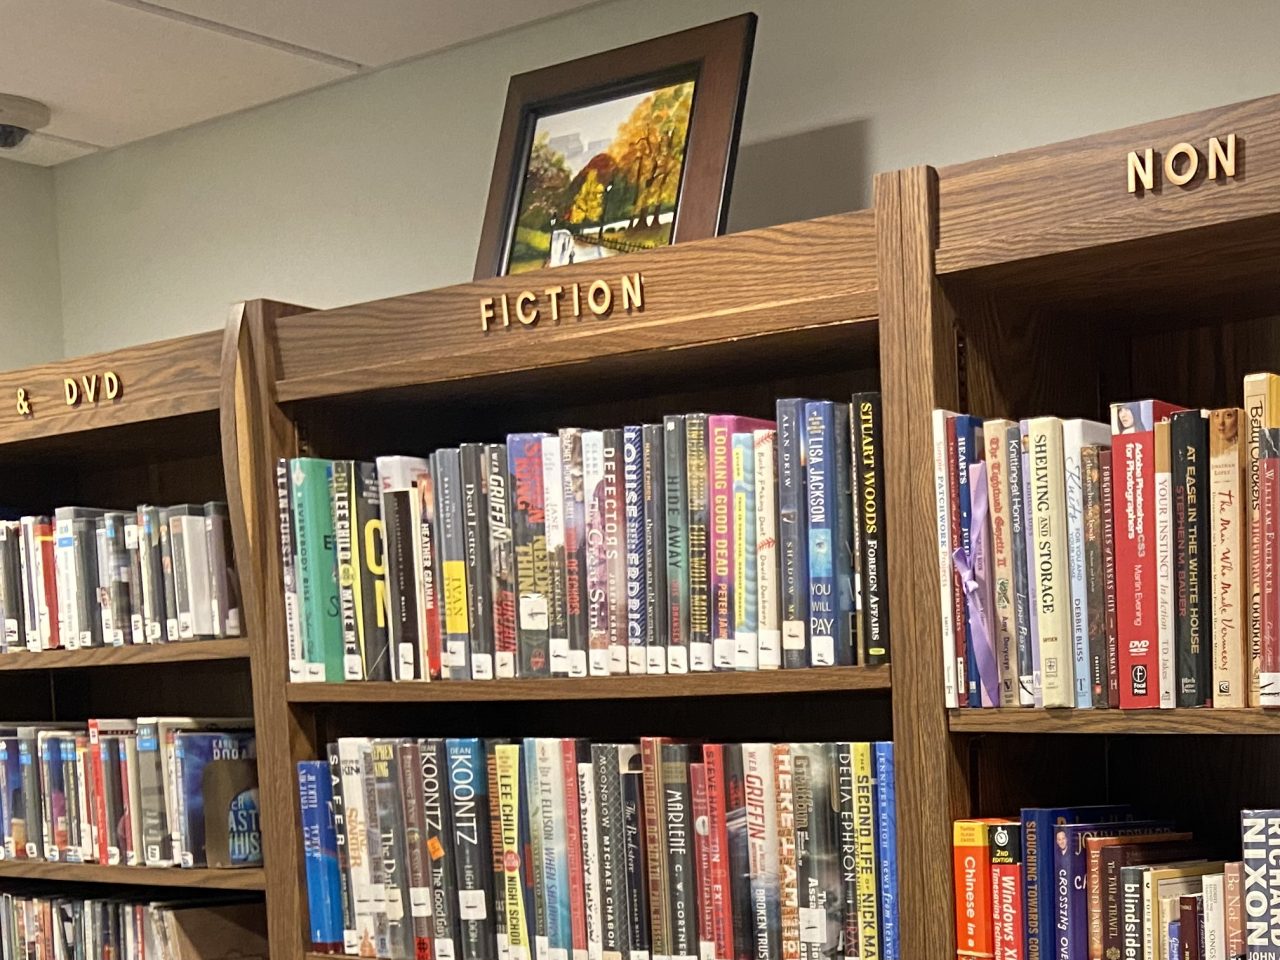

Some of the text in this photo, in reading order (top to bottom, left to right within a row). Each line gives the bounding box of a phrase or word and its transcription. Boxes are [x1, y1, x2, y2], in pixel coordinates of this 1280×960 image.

[1127, 133, 1236, 193] NON
[481, 273, 644, 332] FICTION
[16, 372, 123, 415] & DVD
[466, 484, 474, 514] Dead
[491, 476, 506, 540] GRIFFIN
[714, 428, 727, 576] LOOKING GOOD DEAD
[860, 402, 879, 640] STUART WOODS FOREIGN AFFAIRS
[1034, 434, 1054, 614] SHELVING AND STORAGE
[1126, 460, 1134, 539] Photographers
[1186, 446, 1199, 654] AT EASE IN THE WHITE HOUSE
[811, 584, 830, 595] YOU
[812, 602, 831, 611] WILL
[810, 618, 833, 634] PAY
[421, 752, 441, 830] KOONTZ
[451, 755, 478, 845] KOONTZ
[501, 776, 515, 845] LEE CHILD
[667, 790, 686, 855] MARLENE
[746, 775, 764, 840] GRIFFIN
[840, 754, 855, 882] DELIA EPHRON
[603, 836, 612, 892] MICHAEL
[964, 856, 976, 917] Chinese
[1243, 818, 1269, 946] NIXON
[606, 898, 614, 948] CHABON
[1002, 876, 1015, 940] Windows
[1058, 869, 1068, 929] CROSSING
